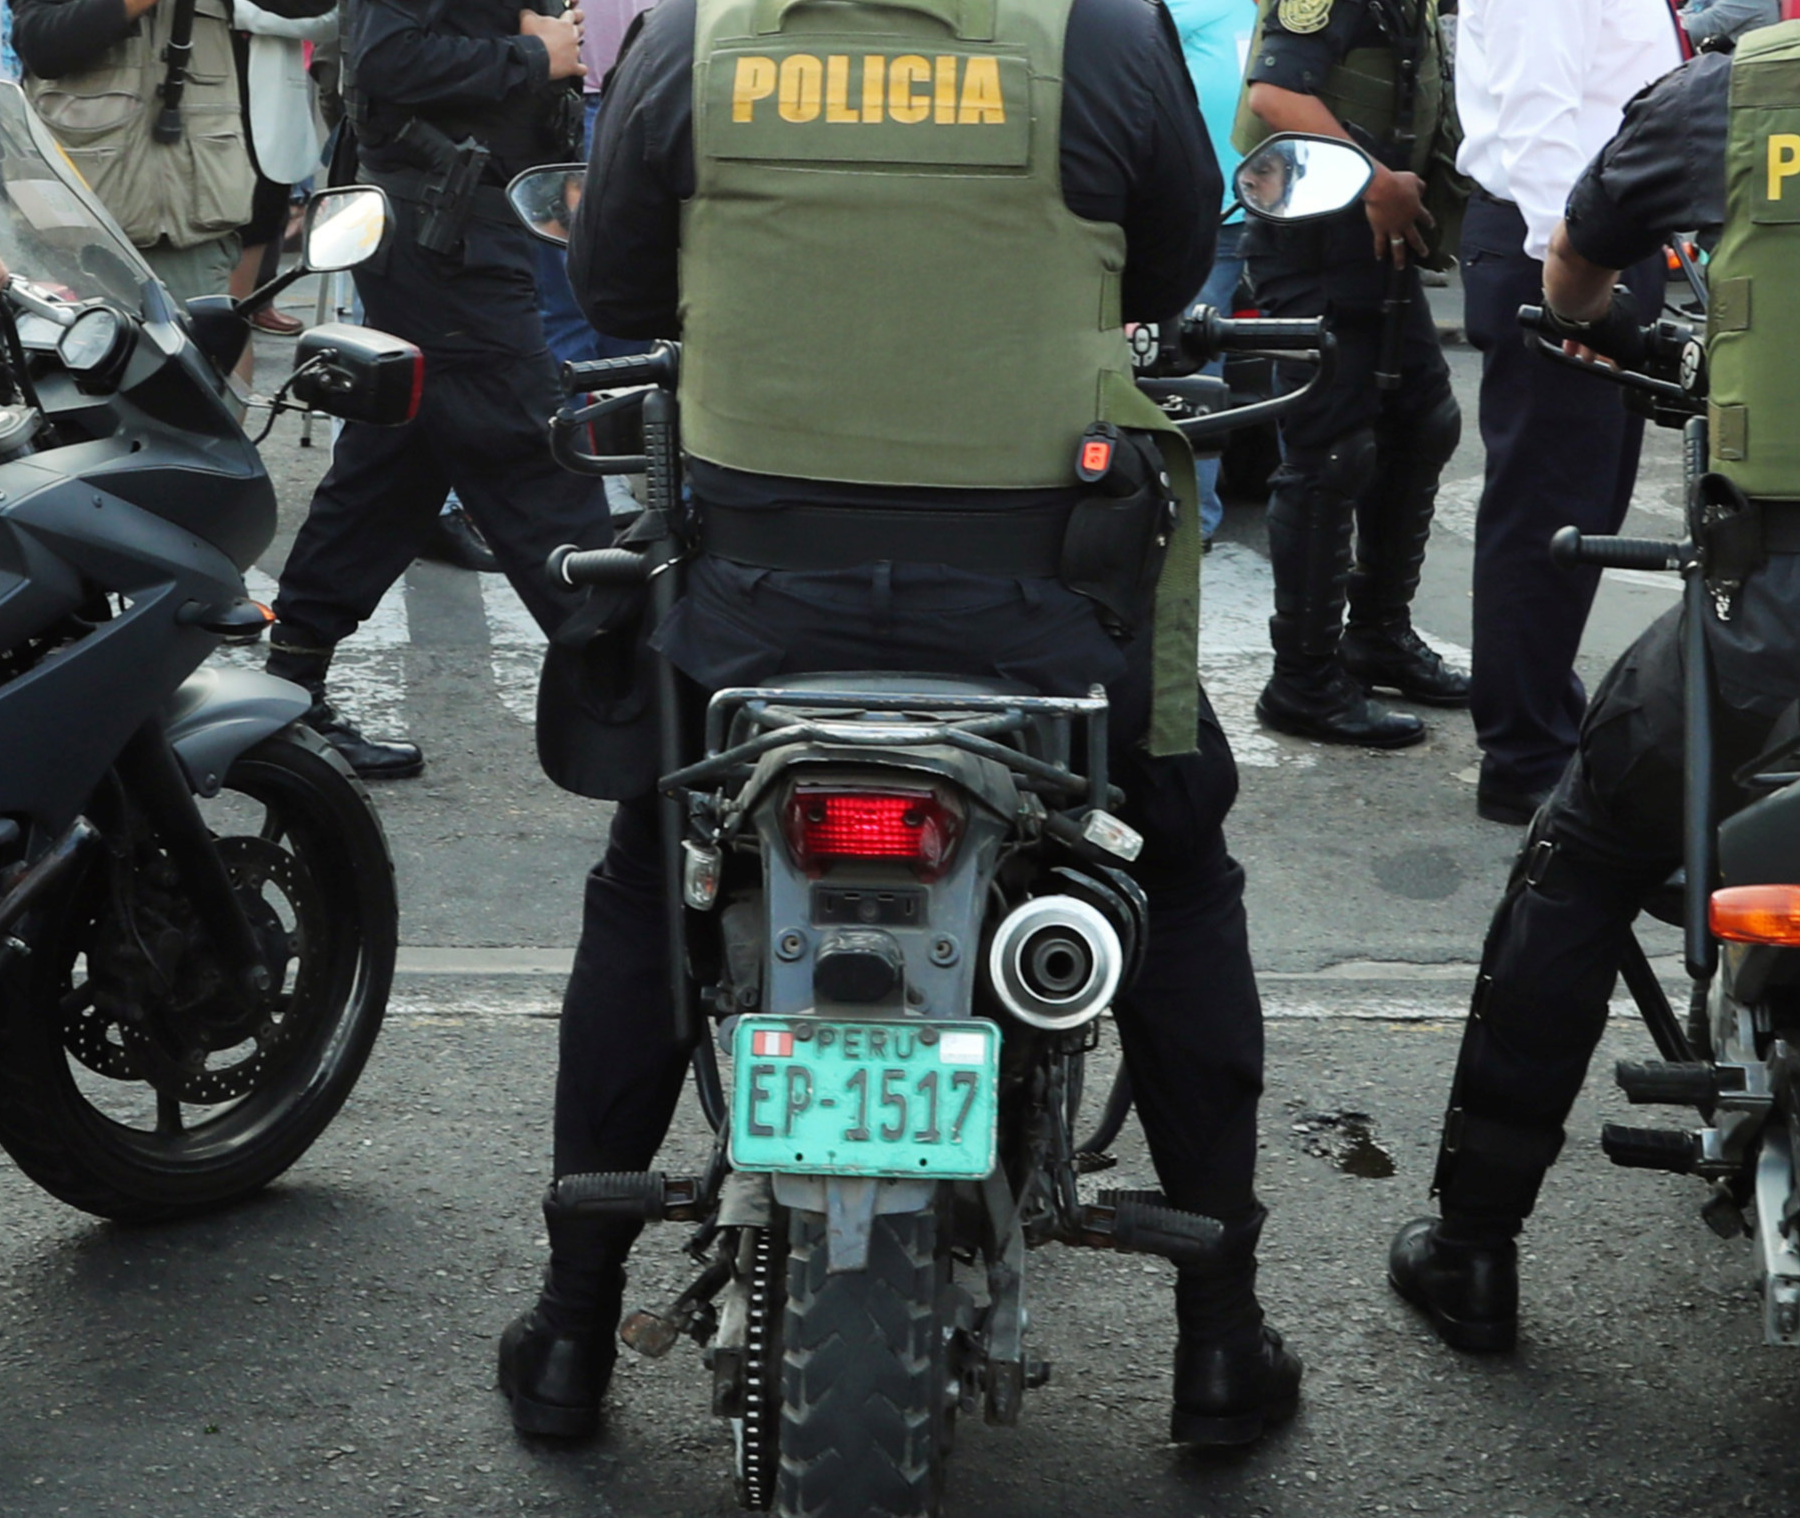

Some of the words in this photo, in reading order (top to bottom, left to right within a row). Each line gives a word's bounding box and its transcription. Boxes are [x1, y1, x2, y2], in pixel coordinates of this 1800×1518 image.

[731, 53, 1006, 125] POLICIA
[816, 1029, 915, 1060] PERU
[747, 1063, 979, 1145] EP-1517
